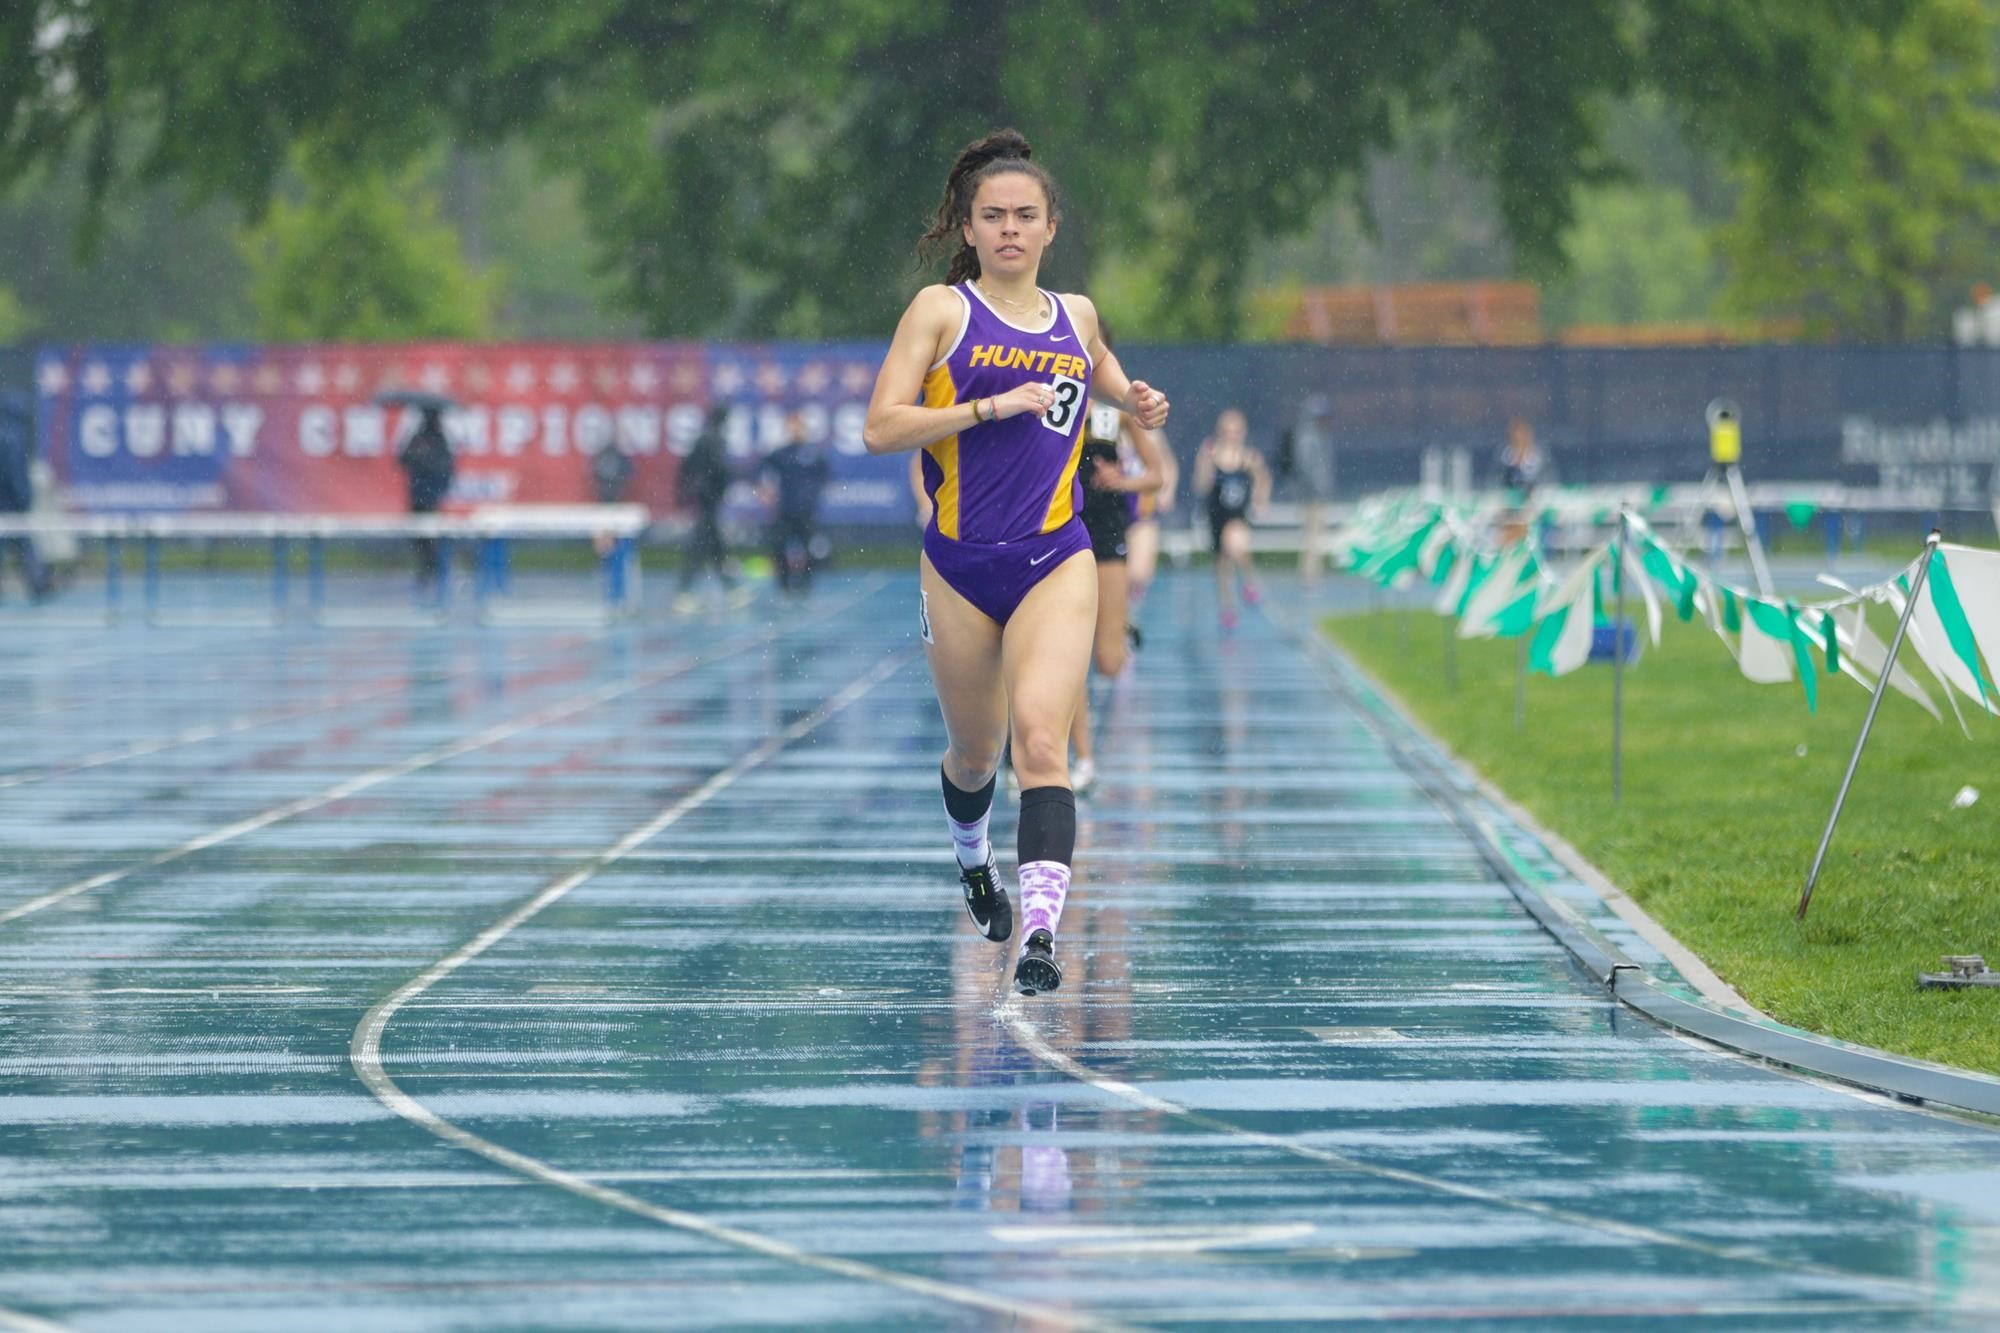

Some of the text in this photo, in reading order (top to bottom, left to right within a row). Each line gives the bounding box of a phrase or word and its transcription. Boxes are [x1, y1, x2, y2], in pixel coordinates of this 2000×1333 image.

[969, 345, 1087, 379] HUNTER
[1046, 381, 1079, 429] 3
[80, 405, 263, 457] CUNY
